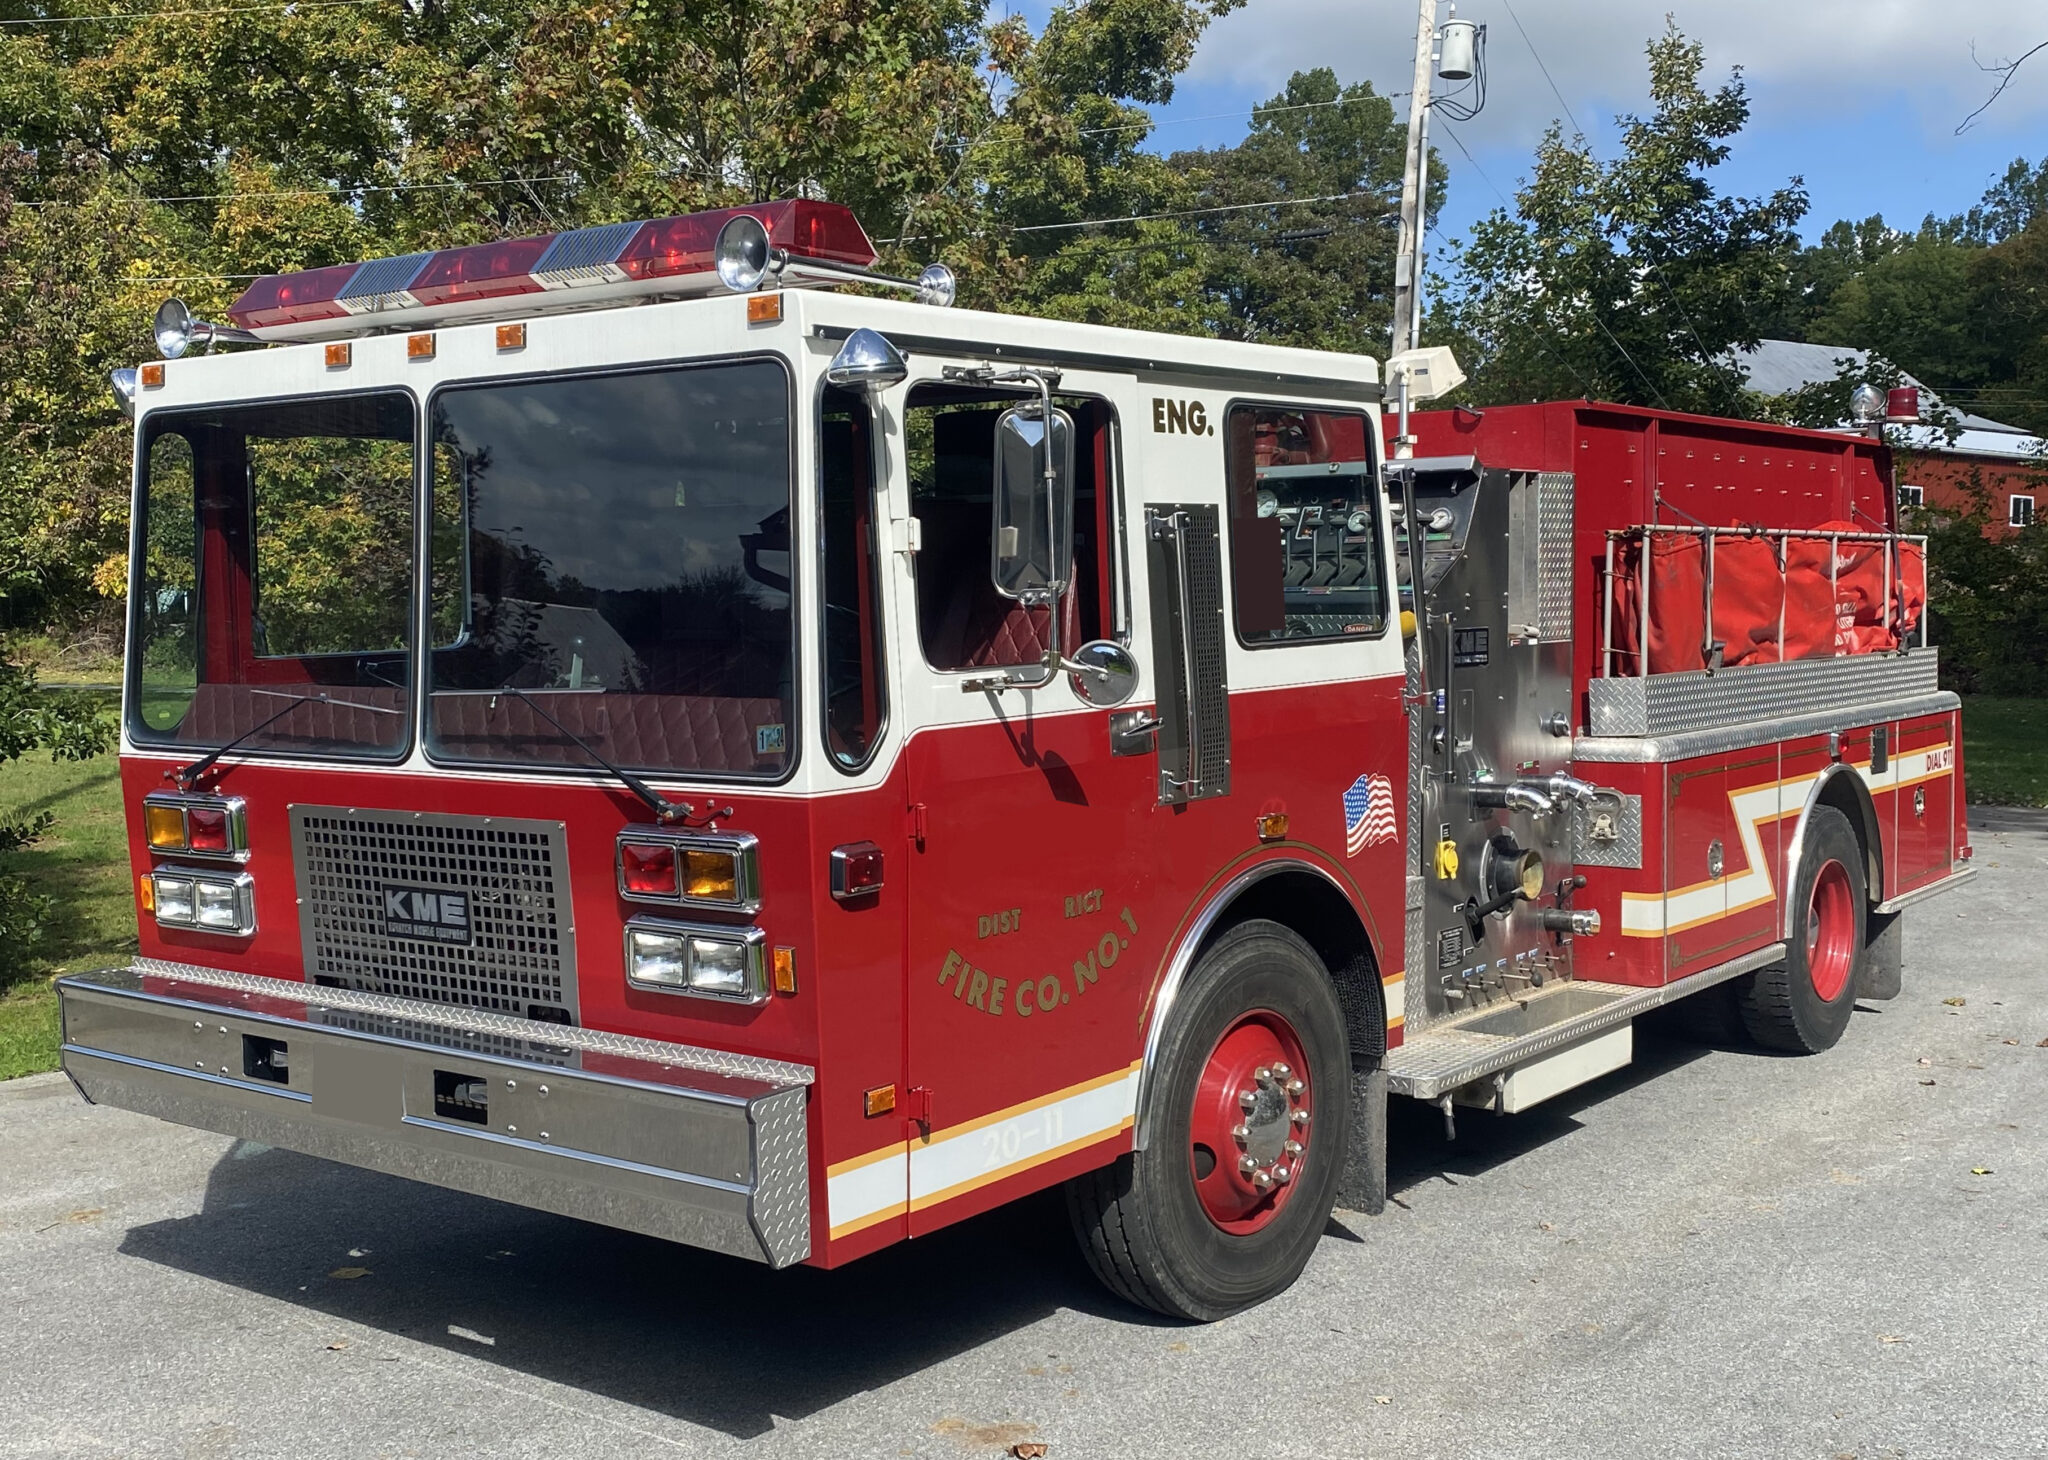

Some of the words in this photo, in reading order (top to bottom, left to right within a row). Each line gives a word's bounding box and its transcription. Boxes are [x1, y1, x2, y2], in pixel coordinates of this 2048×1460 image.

[1152, 398, 1214, 437] ENG.
[1927, 752, 1942, 772] DIAL
[1943, 749, 1953, 767] 911
[384, 889, 467, 926] KME
[977, 908, 1022, 940] DIST
[1063, 889, 1105, 919] RICT
[937, 948, 1009, 1016] FIRE
[1015, 975, 1070, 1017] CO.
[983, 1107, 1064, 1168] 20-11
